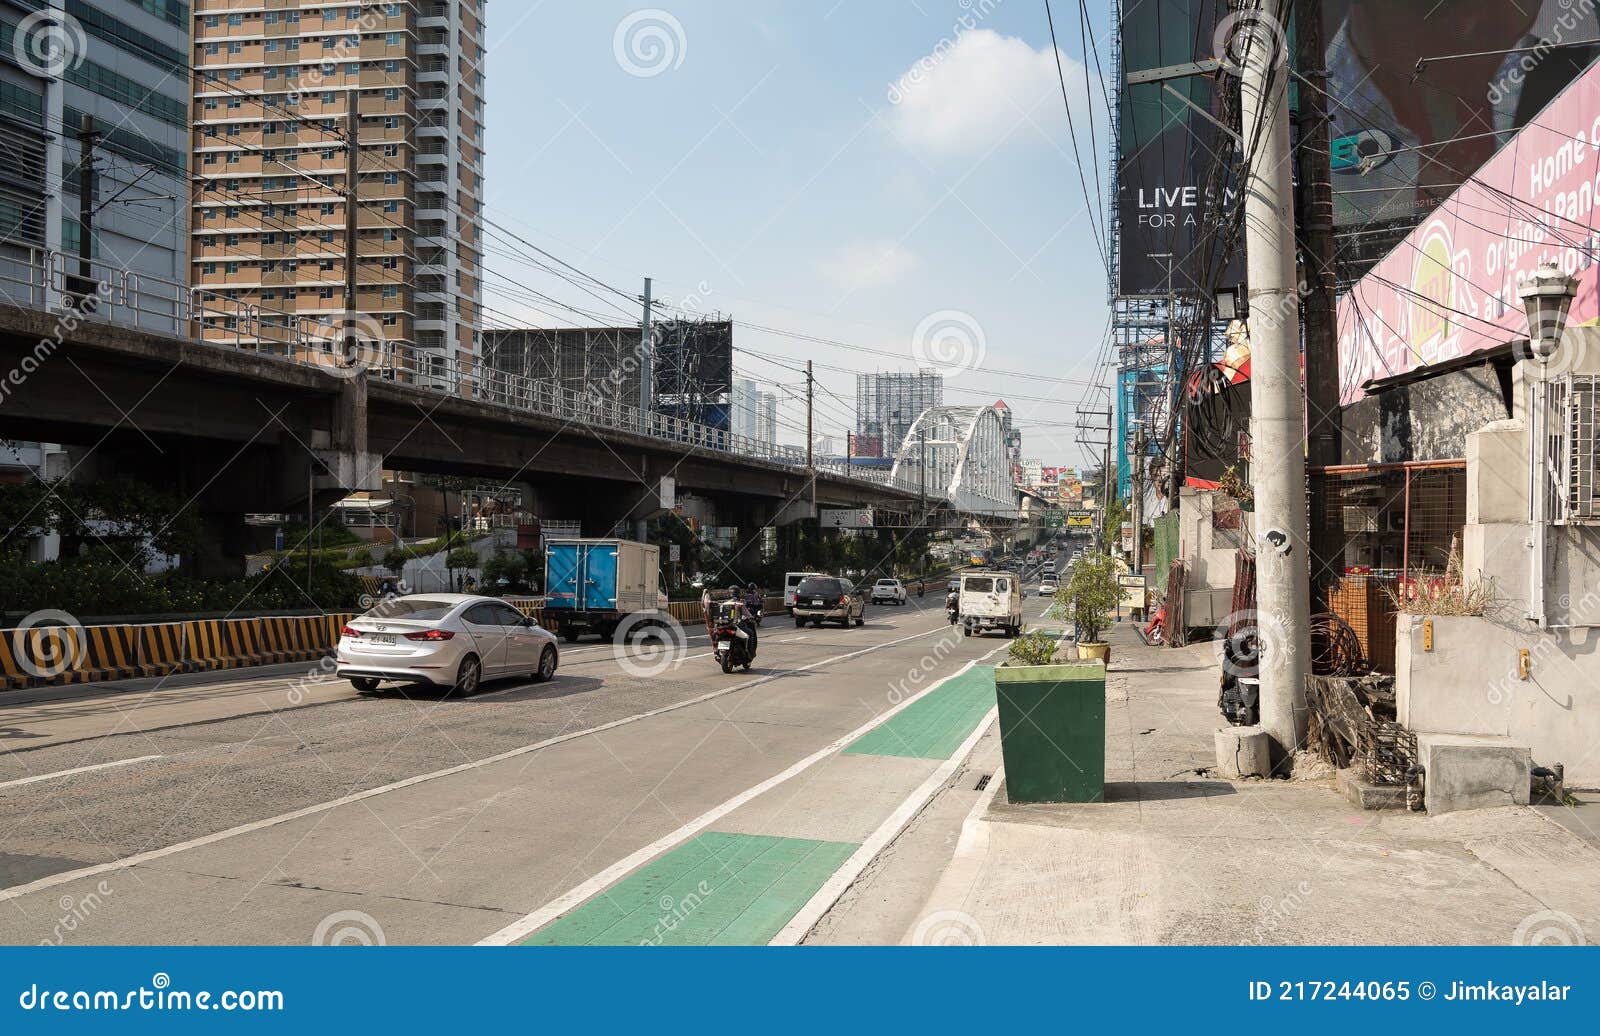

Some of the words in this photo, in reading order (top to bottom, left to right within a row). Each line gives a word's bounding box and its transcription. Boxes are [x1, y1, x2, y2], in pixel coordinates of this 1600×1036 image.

[1530, 130, 1586, 198] Home
[1138, 186, 1197, 208] LIVE
[1138, 213, 1176, 228] FOR
[1183, 213, 1197, 226] A
[1485, 199, 1550, 276] Original
